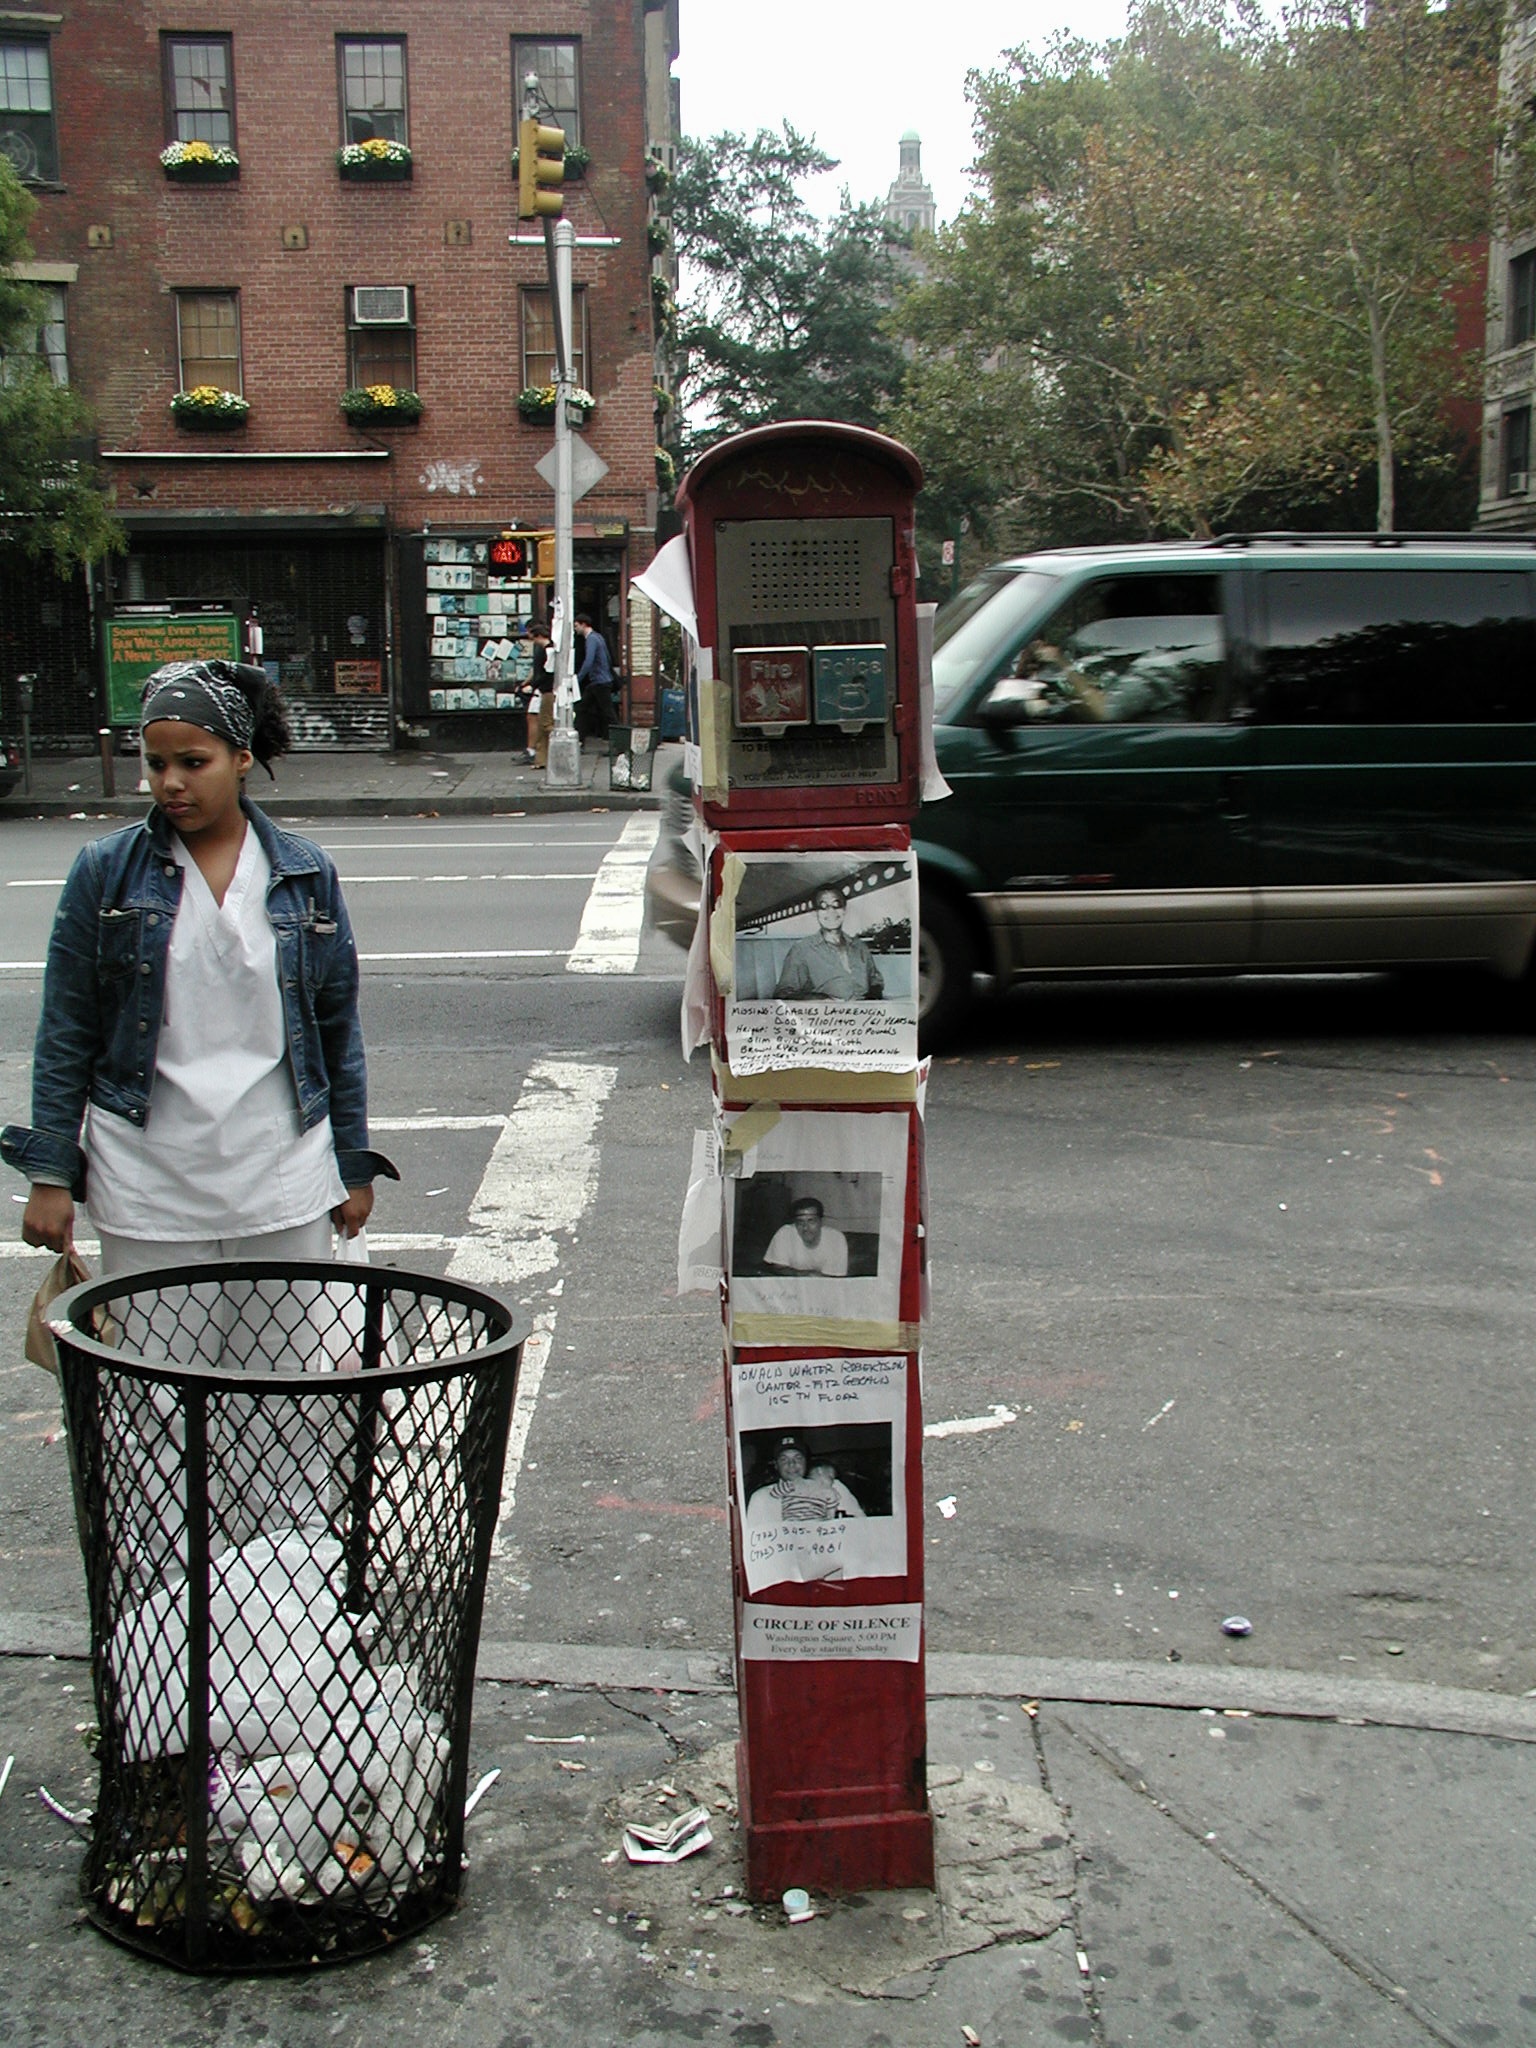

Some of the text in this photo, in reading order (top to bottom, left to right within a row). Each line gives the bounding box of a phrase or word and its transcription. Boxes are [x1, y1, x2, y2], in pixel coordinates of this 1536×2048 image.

[167, 626, 196, 636] EVERY
[113, 651, 122, 662] A
[124, 651, 151, 662] NEW
[751, 660, 792, 679] Fire
[820, 657, 882, 675] Police
[858, 770, 878, 778] HELP
[855, 790, 899, 804] FDNY
[789, 1363, 835, 1377] WALTER
[841, 1360, 905, 1373] ROBERTSON
[753, 1616, 911, 1631] CIRCLE OF SILENCE
[765, 1633, 820, 1643] Washington
[880, 1632, 897, 1641] PM
[771, 1644, 889, 1655] Every day starting Sunday
